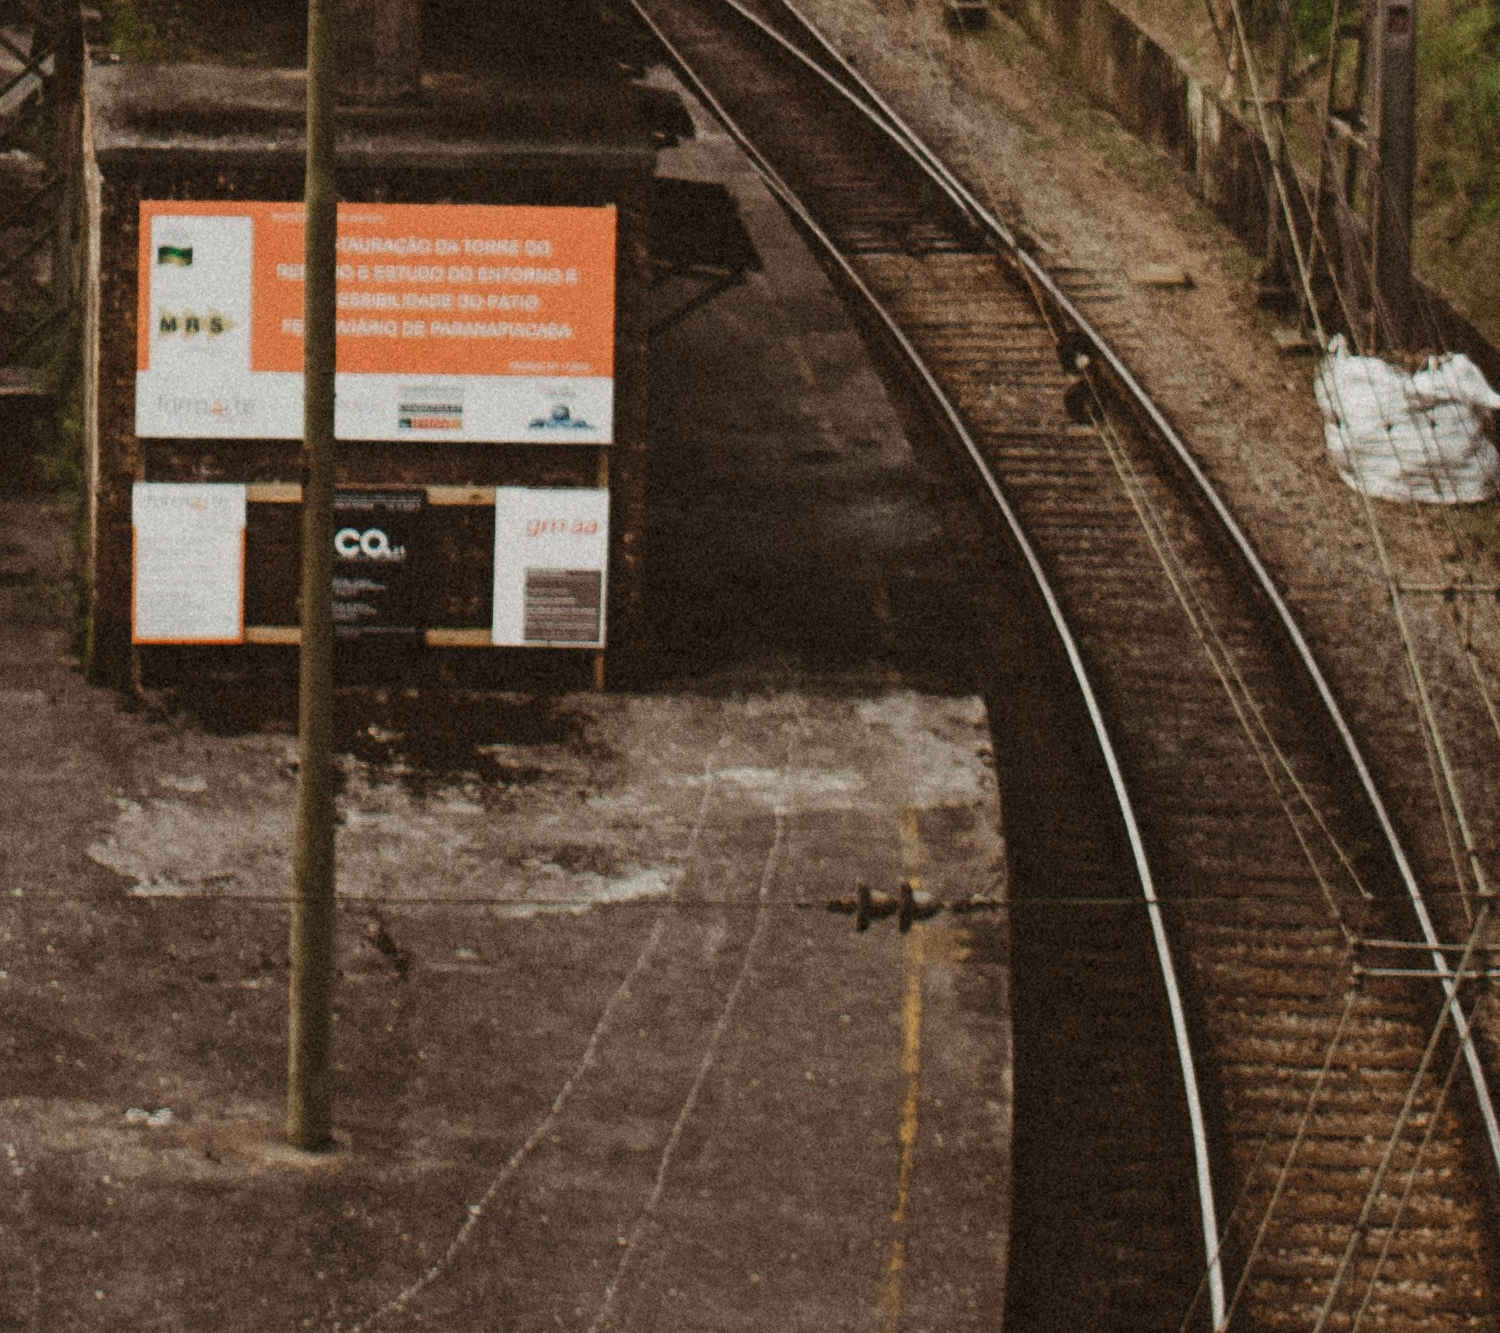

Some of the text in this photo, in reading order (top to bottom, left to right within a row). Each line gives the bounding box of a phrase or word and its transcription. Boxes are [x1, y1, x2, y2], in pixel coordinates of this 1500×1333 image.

[374, 264, 444, 283] ESTUDO
[477, 266, 562, 285] ENTORNO
[401, 320, 426, 338] DE
